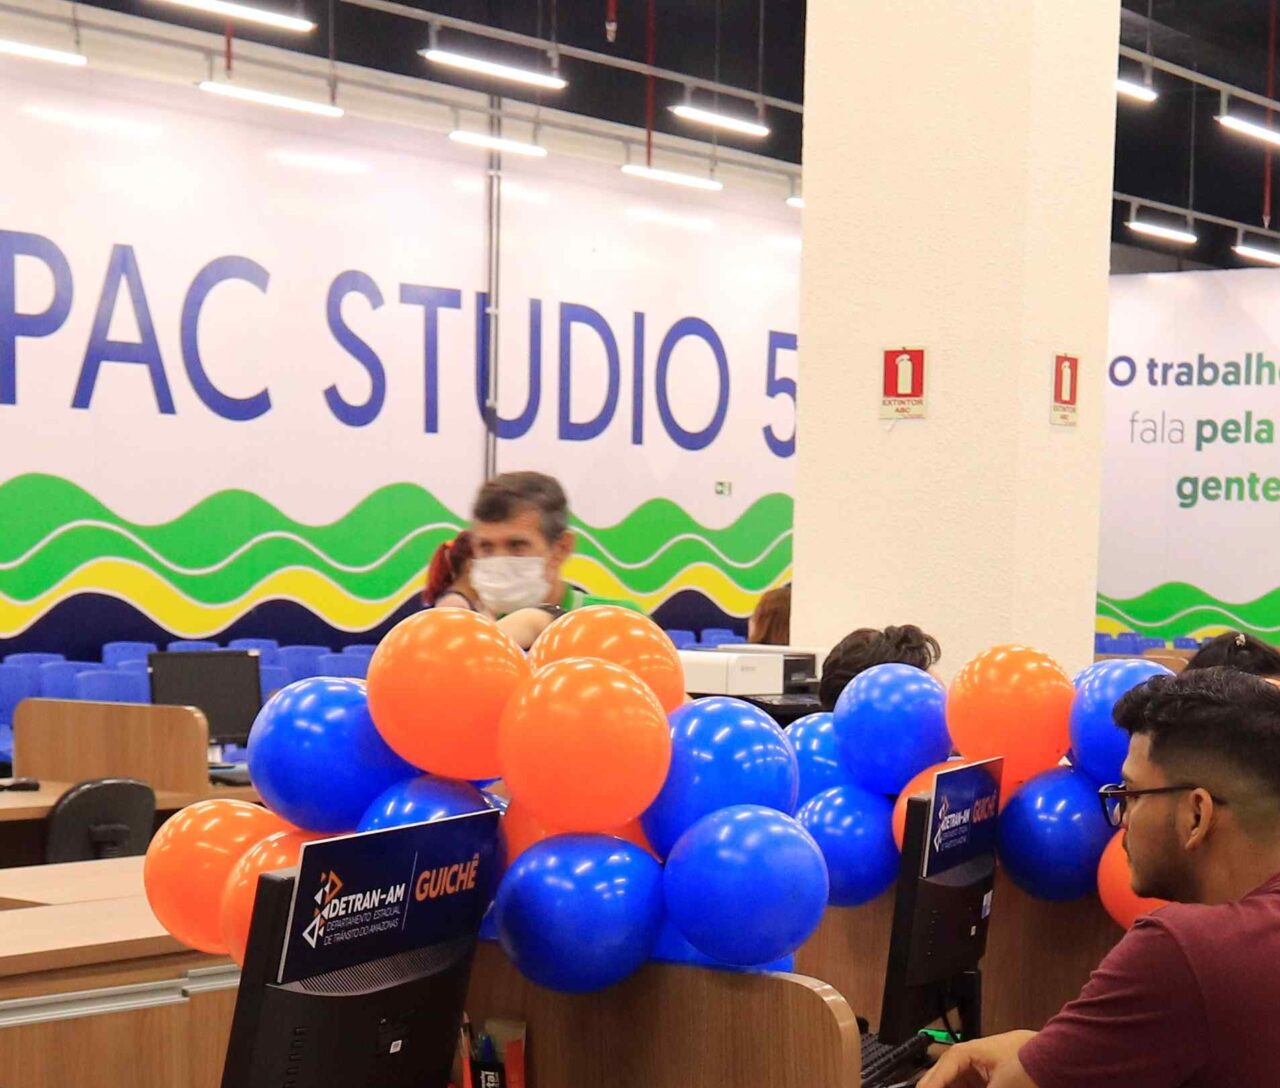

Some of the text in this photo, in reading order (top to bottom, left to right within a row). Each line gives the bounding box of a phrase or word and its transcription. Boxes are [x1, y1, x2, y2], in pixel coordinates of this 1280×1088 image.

[0, 229, 798, 458] PAC STUDIO 5
[1108, 355, 1137, 387] O
[882, 399, 924, 407] EXTINTOR
[1129, 410, 1275, 452] fala pela
[329, 852, 480, 919] DETRAN-AM GUICHÊ
